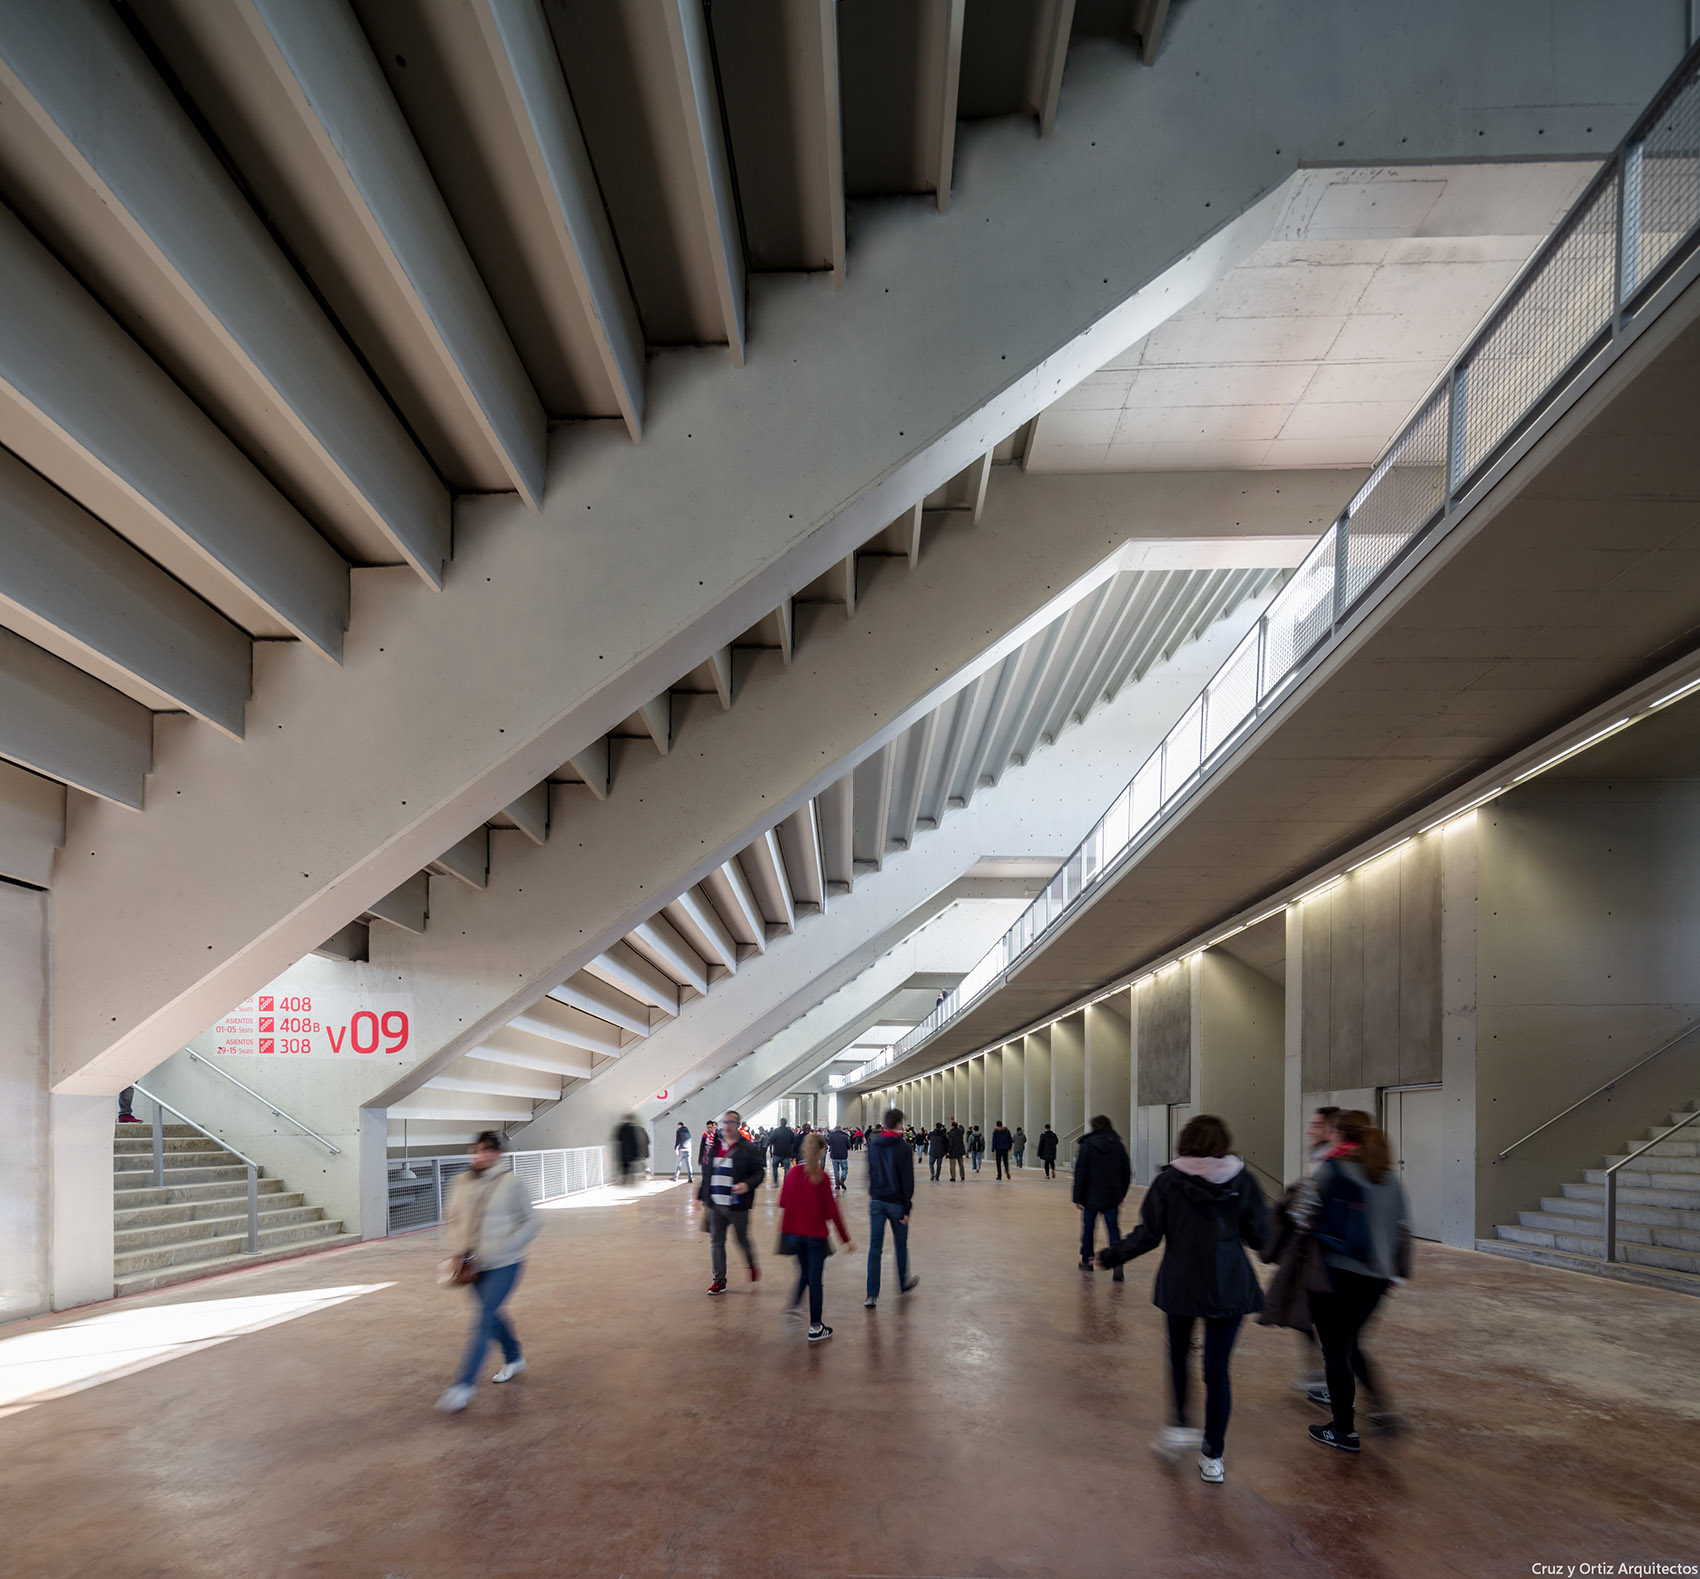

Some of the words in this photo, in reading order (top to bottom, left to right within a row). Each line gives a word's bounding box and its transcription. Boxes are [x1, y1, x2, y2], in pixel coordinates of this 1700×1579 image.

[279, 996, 312, 1012] 408
[325, 1010, 409, 1054] v09
[217, 1046, 237, 1054] 29-15
[279, 1038, 312, 1054] 308
